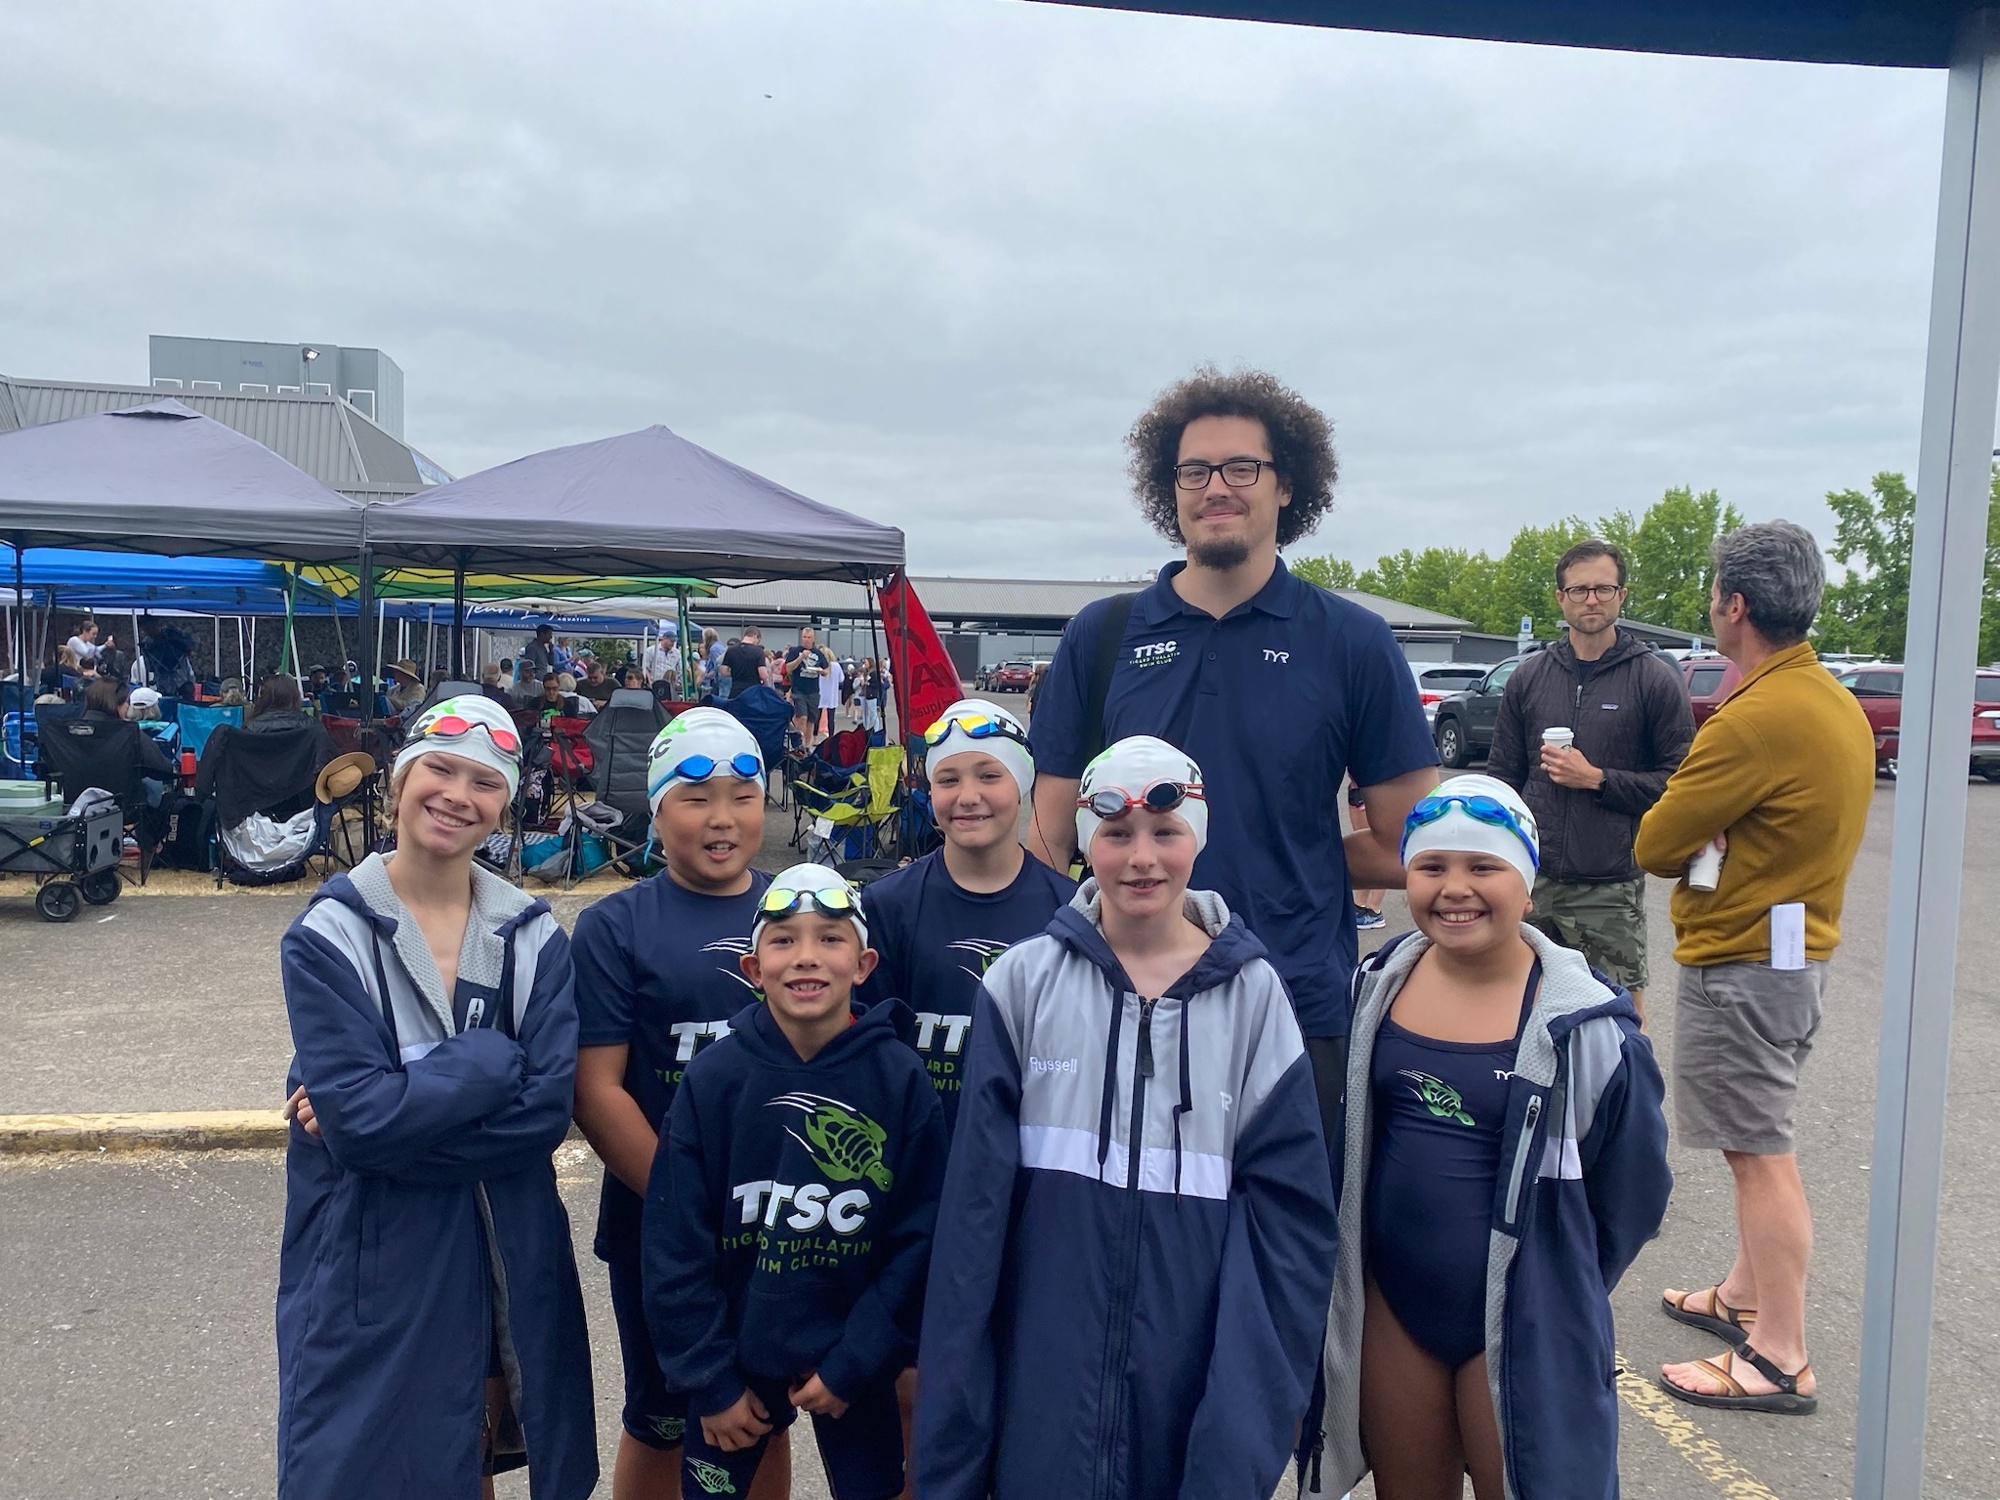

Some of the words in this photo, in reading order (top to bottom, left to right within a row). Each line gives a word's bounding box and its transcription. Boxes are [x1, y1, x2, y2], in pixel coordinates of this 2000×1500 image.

[1133, 640, 1177, 659] TTSC
[1262, 649, 1290, 664] TYR
[1029, 1056, 1078, 1073] Russell
[1494, 1069, 1515, 1080] TY
[732, 1180, 872, 1236] TTSC
[777, 1236, 872, 1256] TUALATIN
